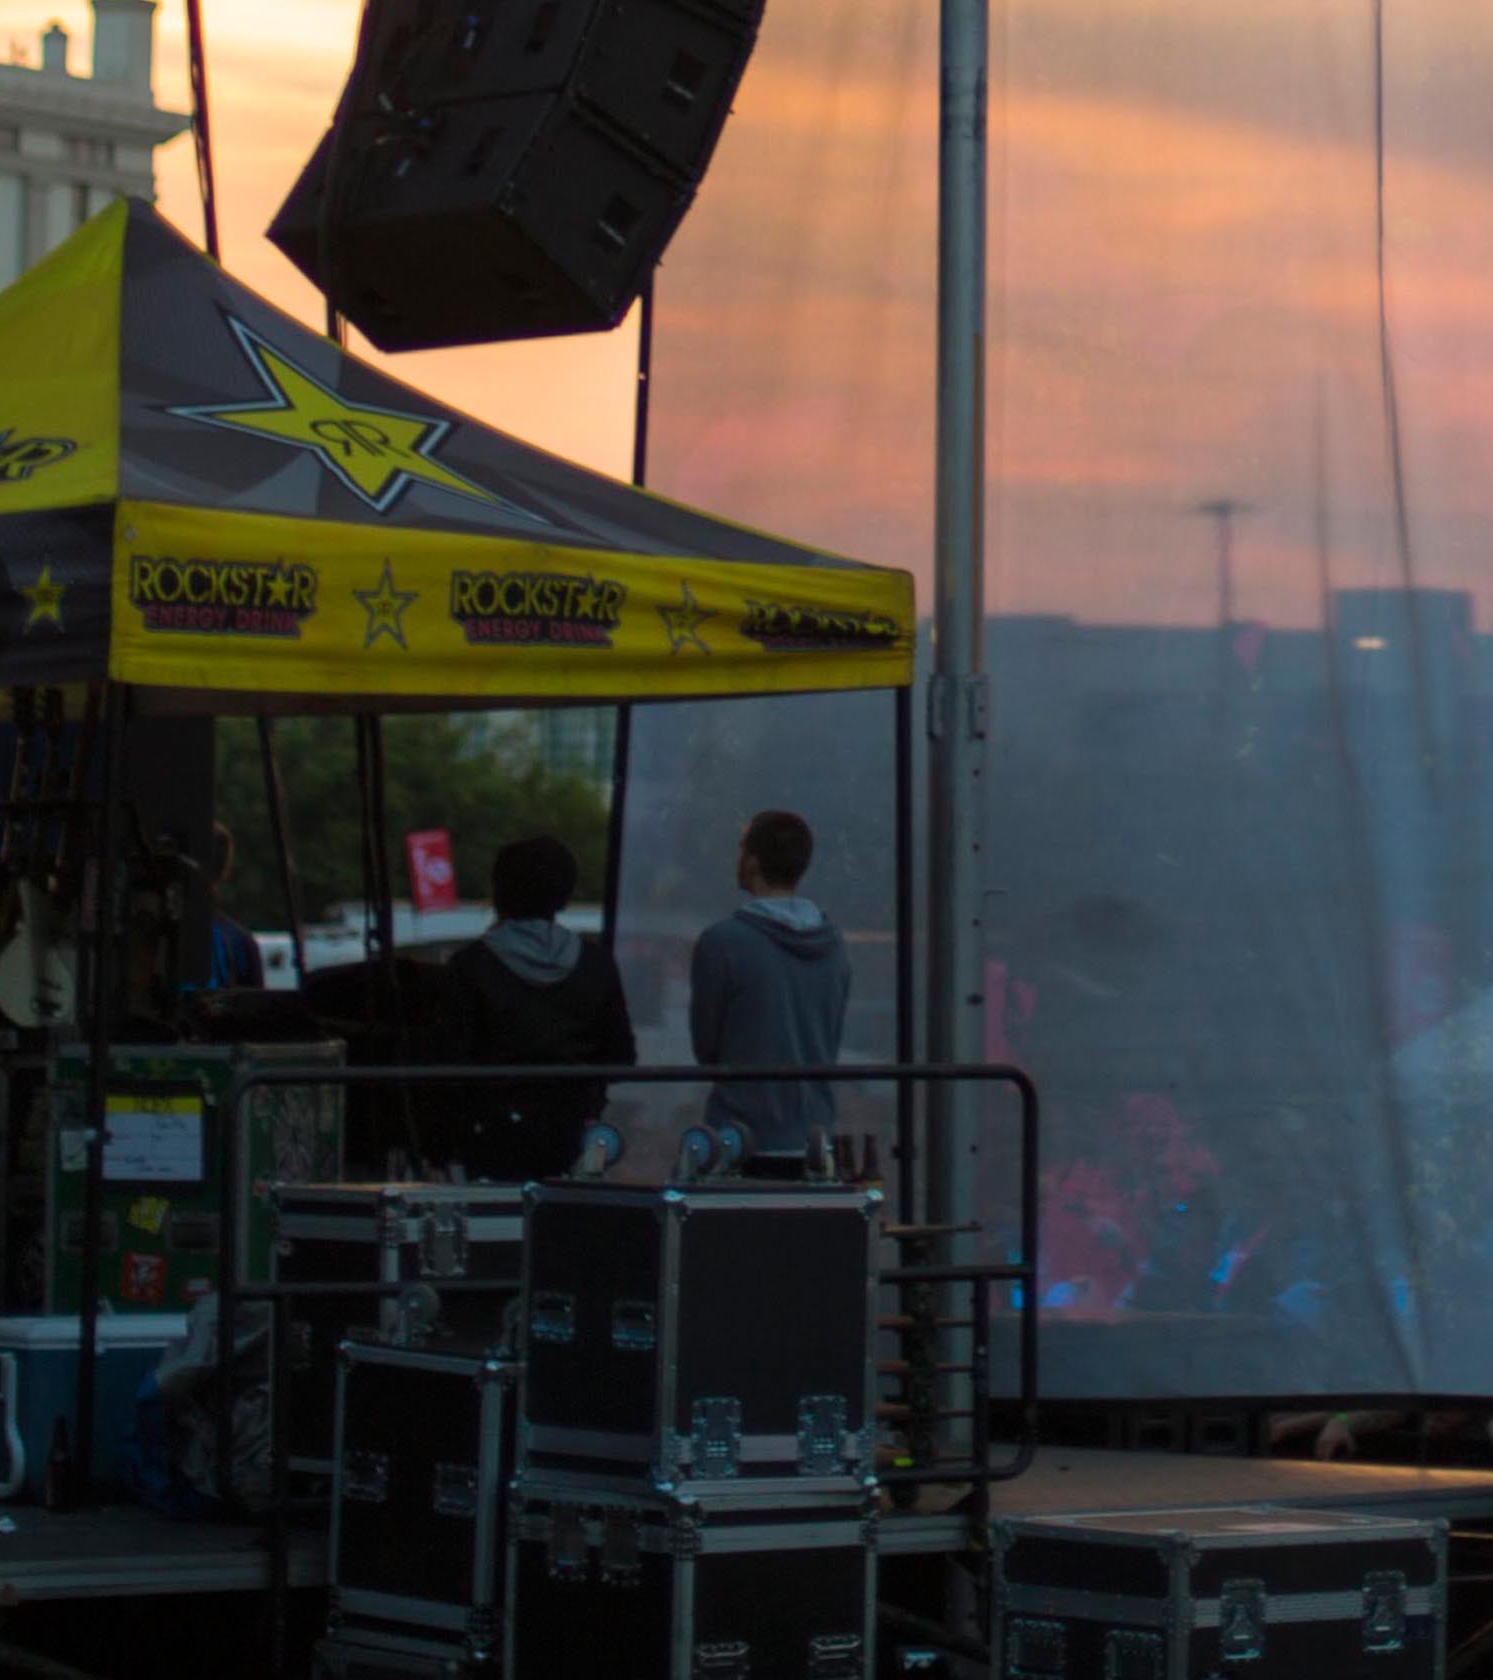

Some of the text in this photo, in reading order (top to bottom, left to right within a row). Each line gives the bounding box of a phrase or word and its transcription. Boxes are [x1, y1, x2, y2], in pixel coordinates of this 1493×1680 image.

[130, 557, 317, 611] ROCKSTAR
[451, 571, 625, 623] ROCKSTAR
[144, 605, 300, 634] ENERGY DRINK
